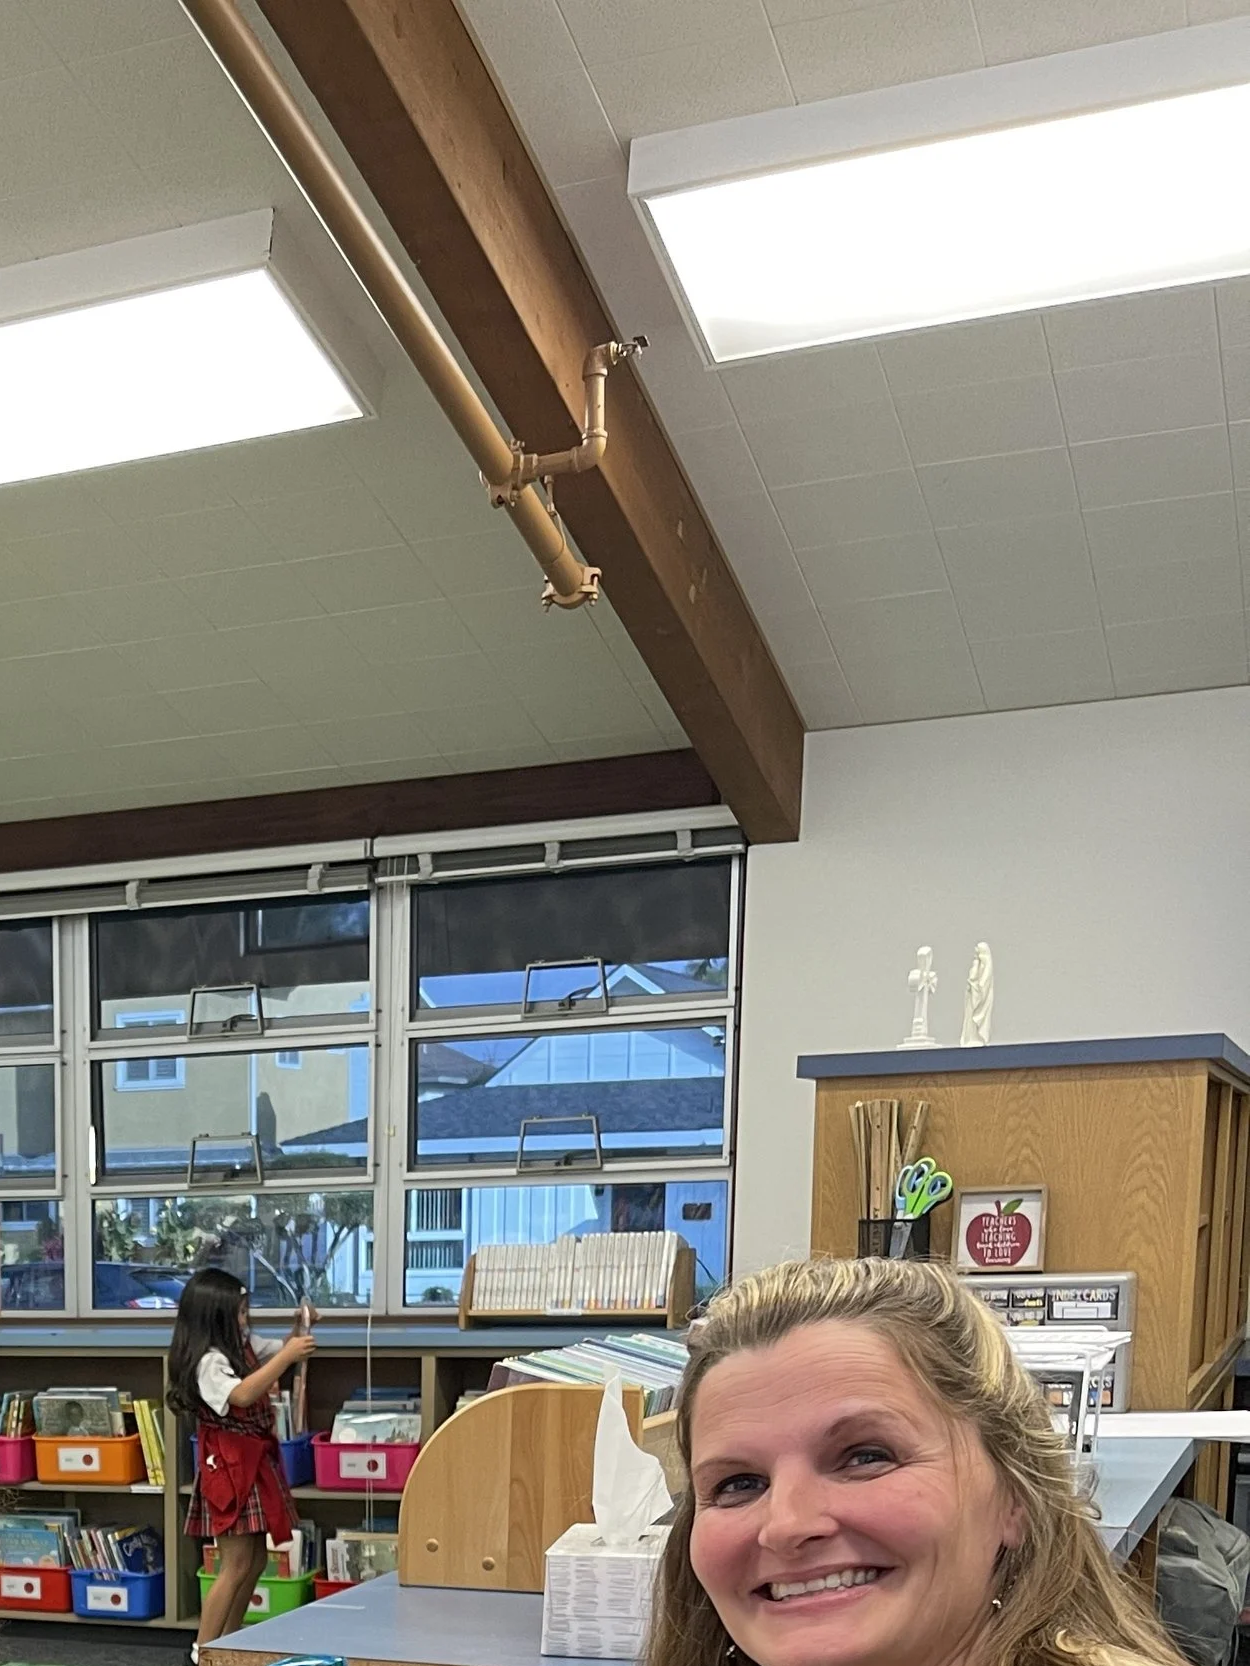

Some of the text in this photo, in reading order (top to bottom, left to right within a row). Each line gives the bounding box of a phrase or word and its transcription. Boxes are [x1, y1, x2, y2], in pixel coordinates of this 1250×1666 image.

[982, 1216, 1016, 1227] TEACHERS
[981, 1232, 1016, 1242] TEACHING
[995, 1247, 1011, 1257] LOVE
[1051, 1289, 1082, 1301] INDEX
[1083, 1288, 1116, 1301] CARDS
